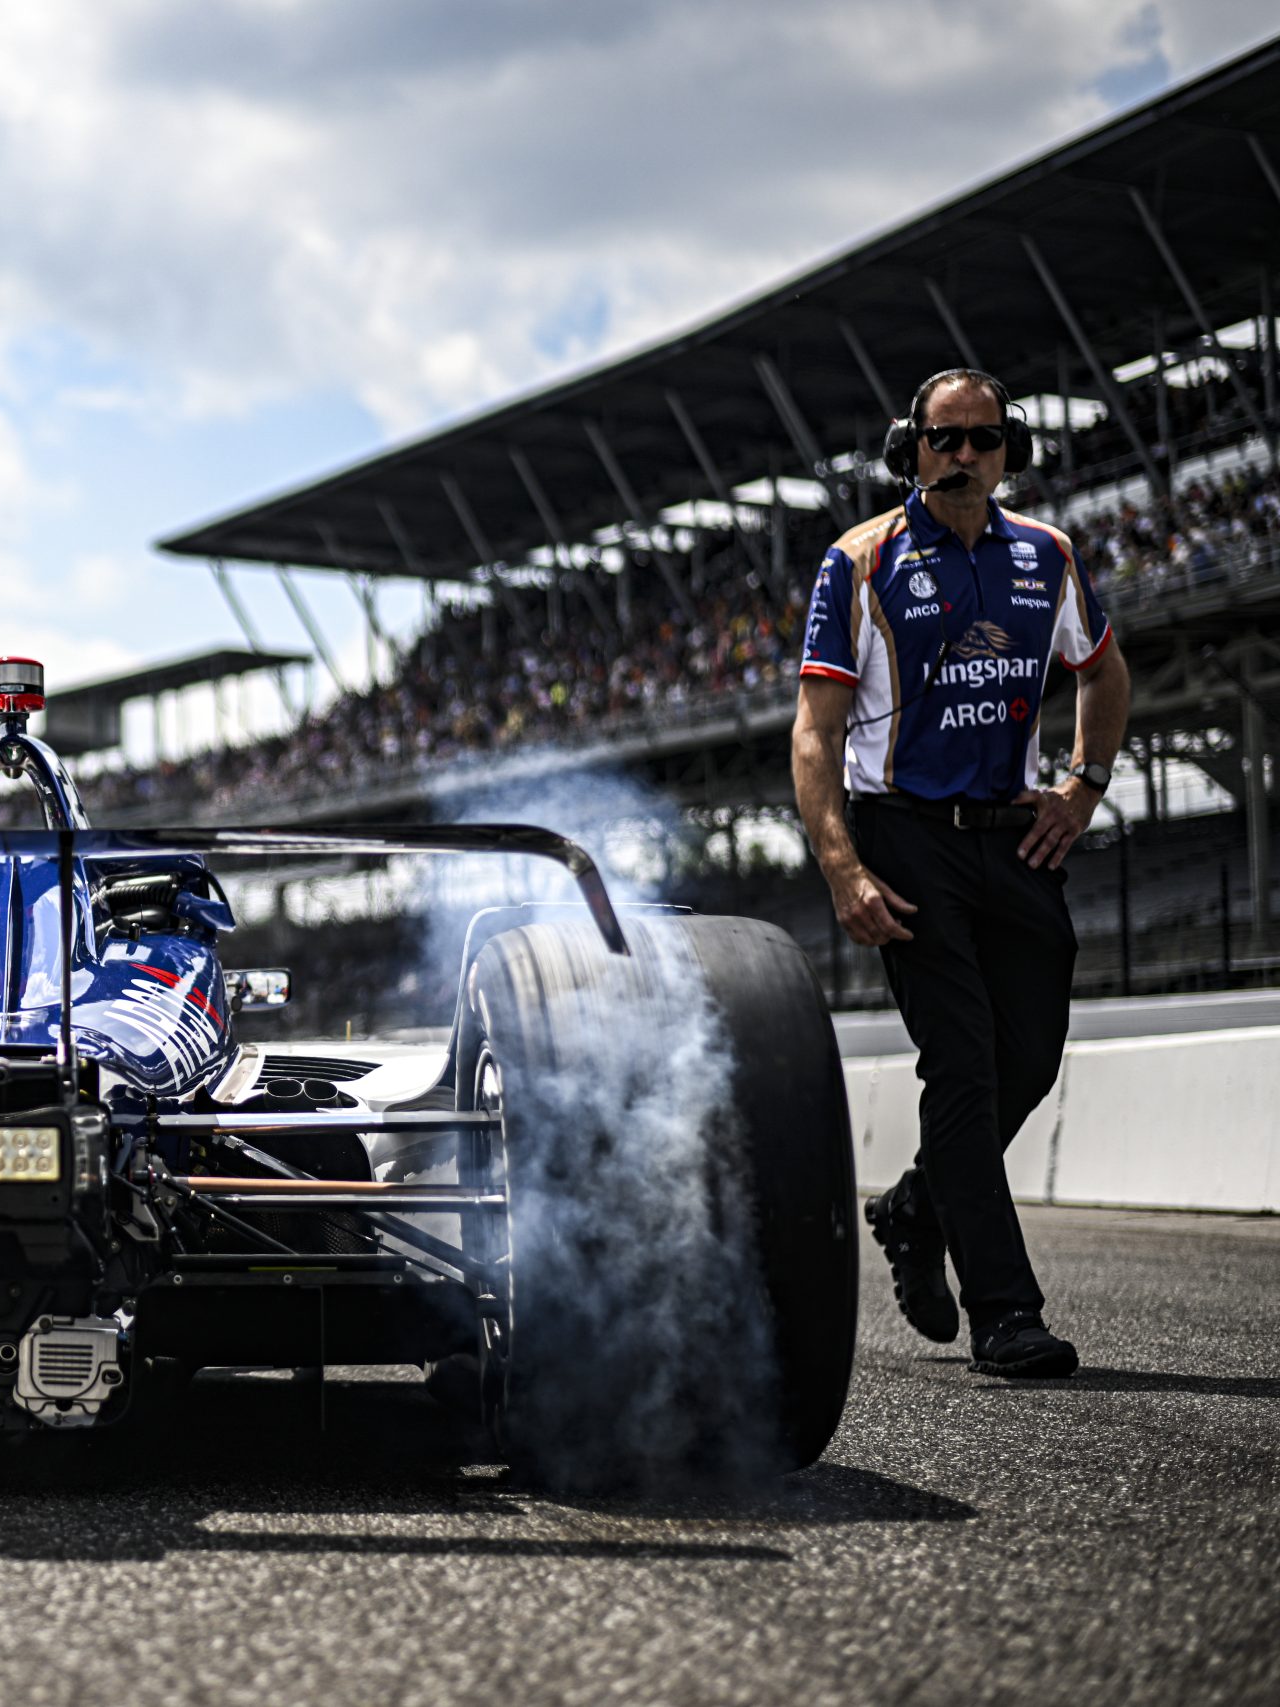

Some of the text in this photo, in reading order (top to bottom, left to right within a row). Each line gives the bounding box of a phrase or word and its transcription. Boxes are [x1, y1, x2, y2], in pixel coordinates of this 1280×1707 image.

[905, 603, 940, 621] ARCO
[1010, 595, 1051, 610] Kingspan
[940, 699, 1007, 731] ARCO
[103, 978, 218, 1092] ARCO
